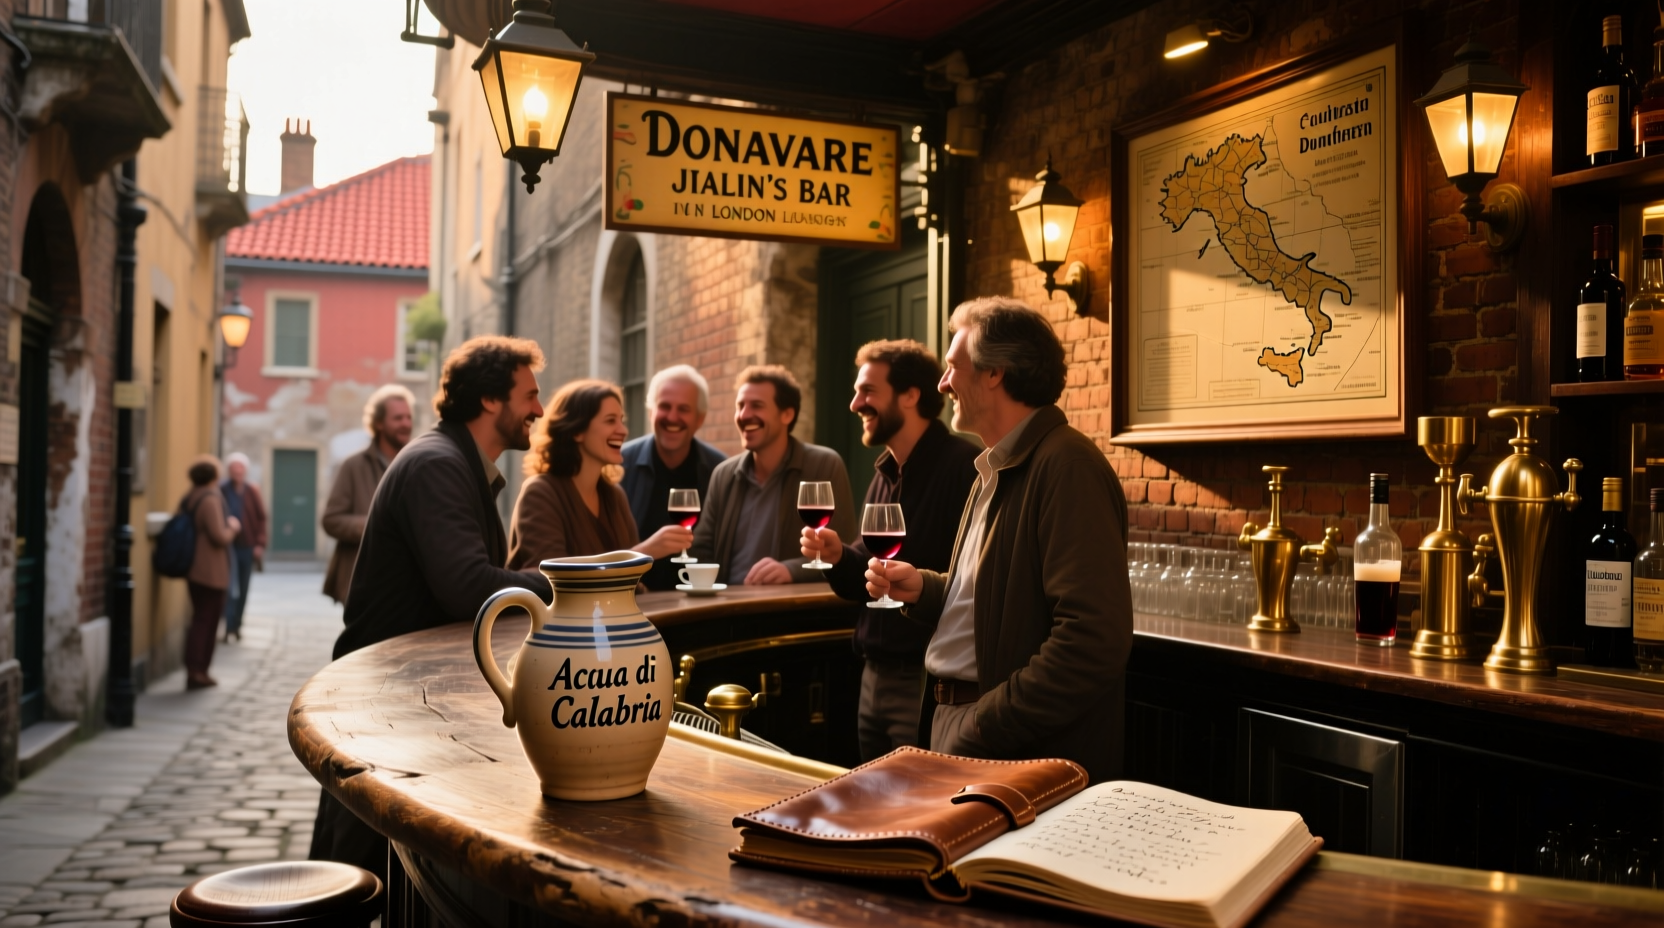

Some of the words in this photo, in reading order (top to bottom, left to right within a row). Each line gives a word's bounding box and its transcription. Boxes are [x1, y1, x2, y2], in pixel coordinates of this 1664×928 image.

[641, 109, 874, 177] DONAVARE
[671, 168, 788, 202] JIALIN'S
[799, 179, 852, 208] BAR
[712, 204, 776, 223] LONDON
[636, 654, 656, 685] di
[551, 693, 663, 729] Calabria
